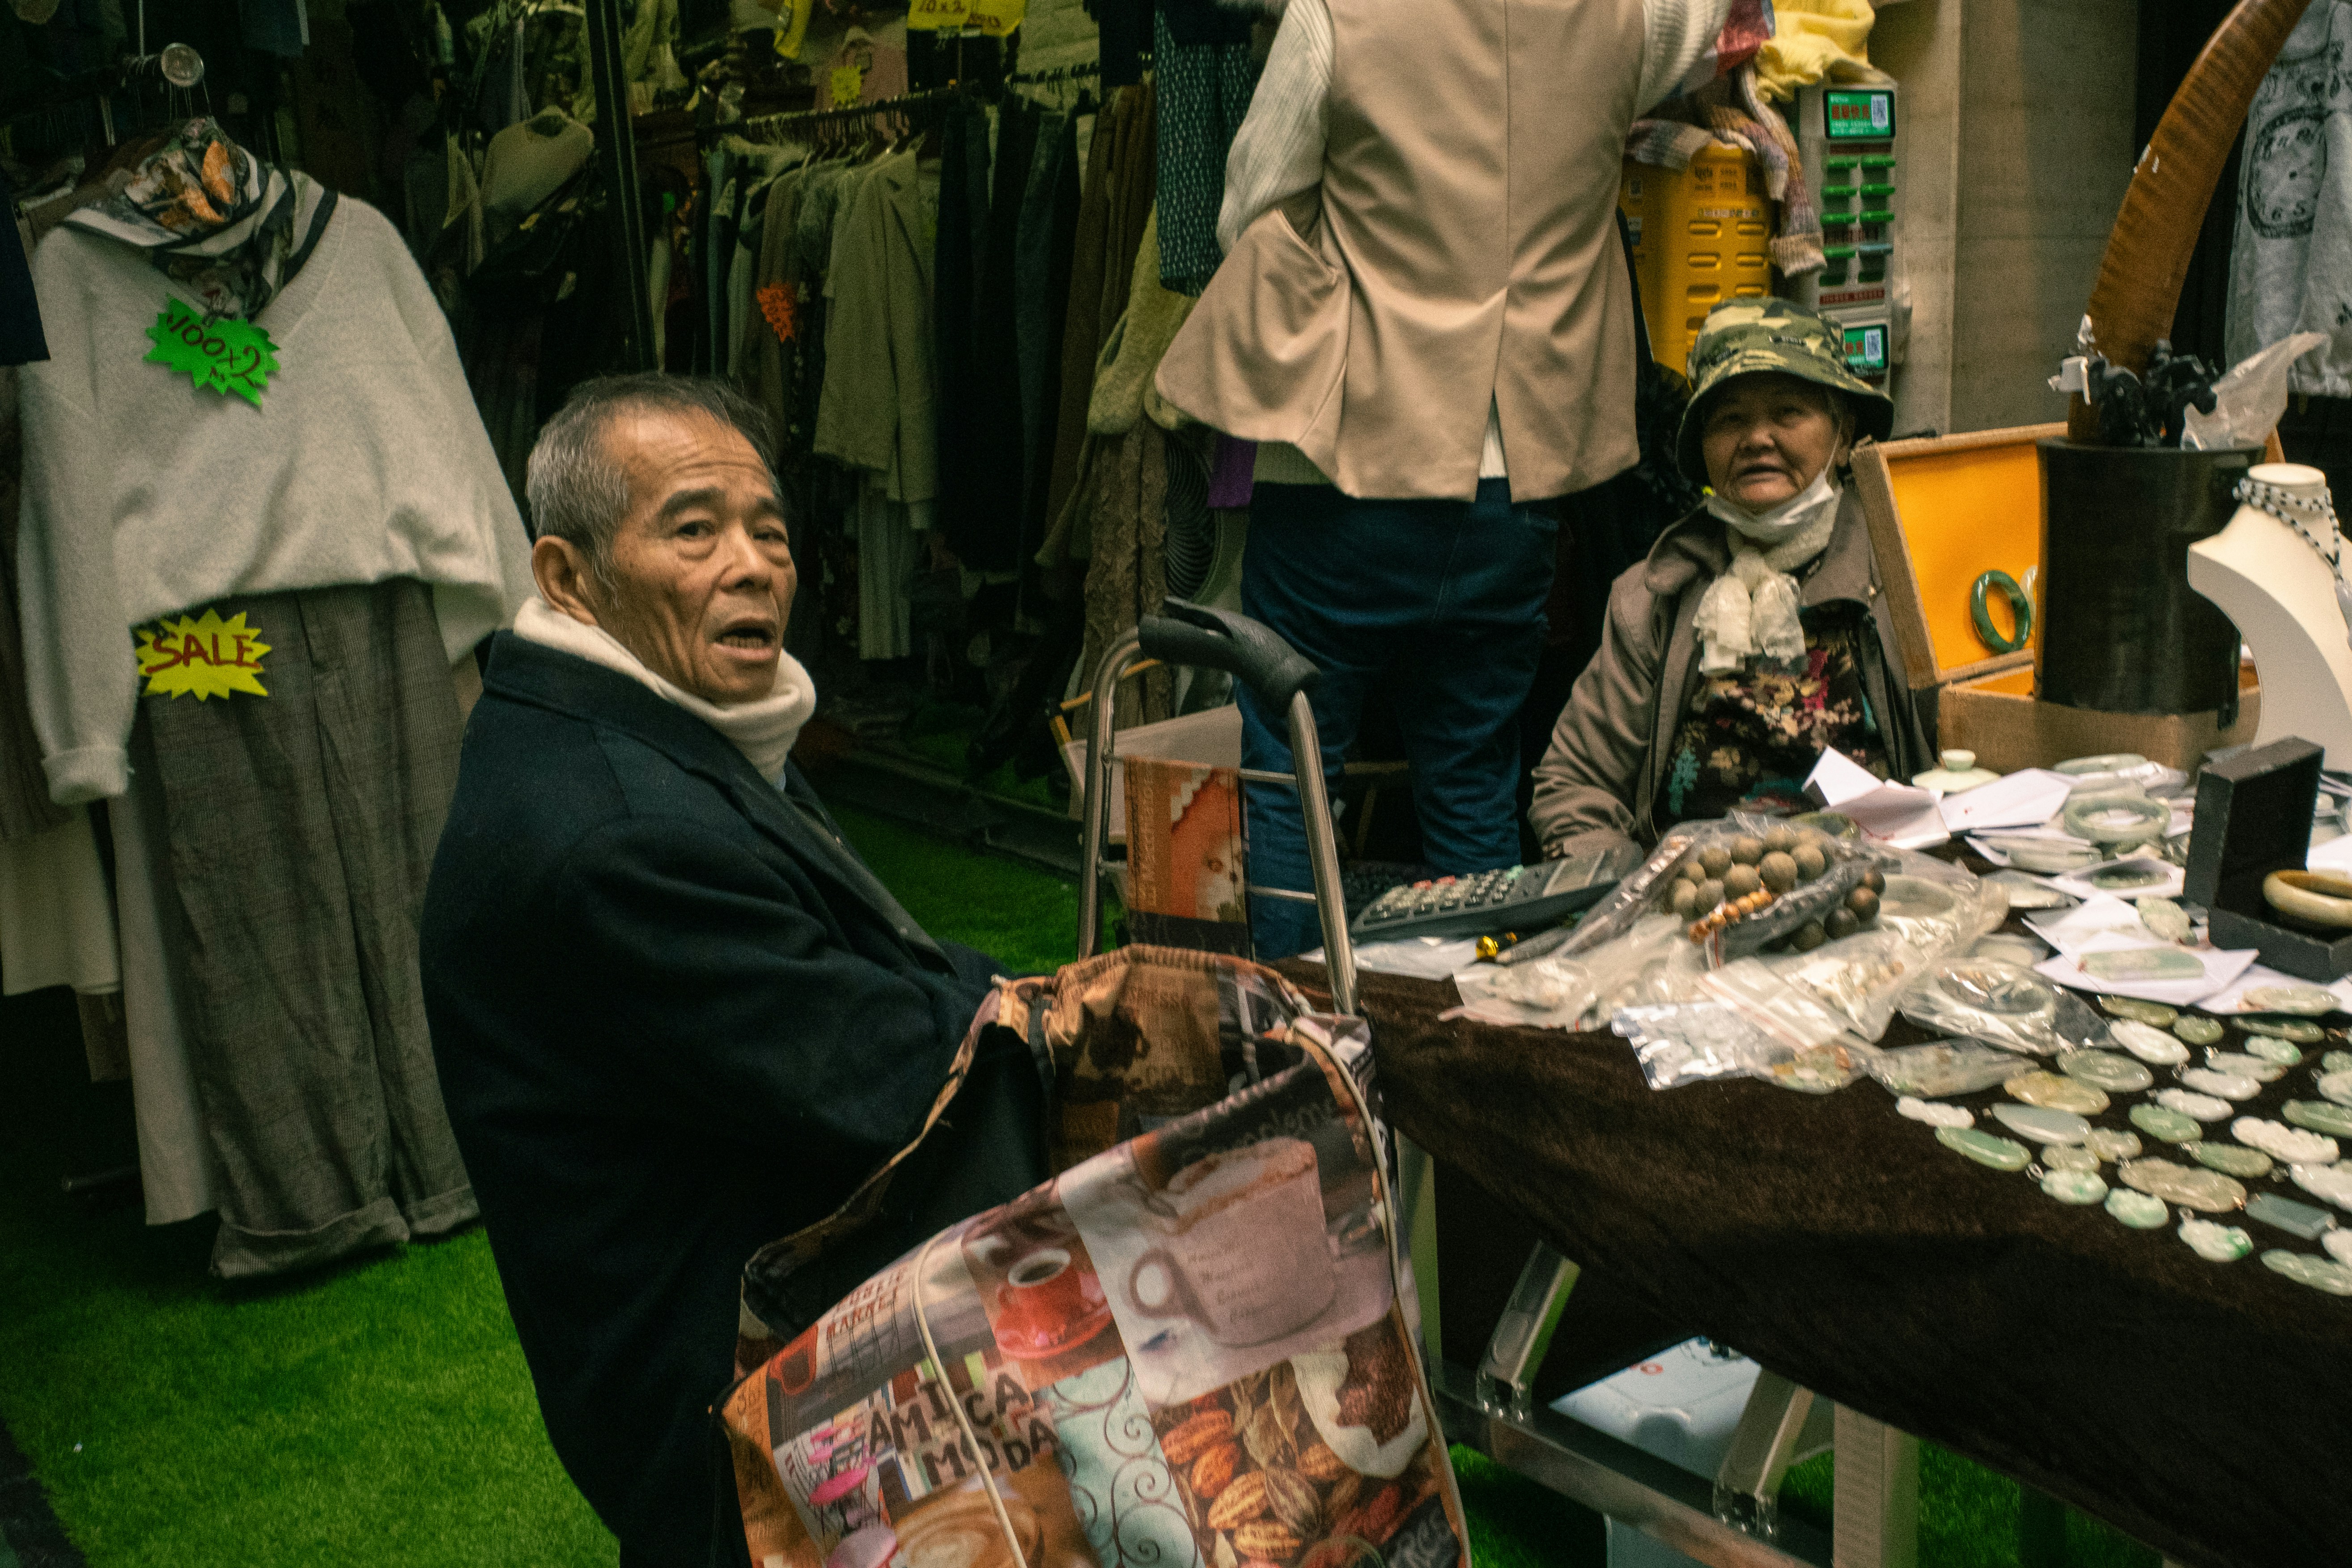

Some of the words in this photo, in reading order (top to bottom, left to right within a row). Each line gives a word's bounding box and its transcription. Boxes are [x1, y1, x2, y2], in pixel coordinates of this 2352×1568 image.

[145, 632, 262, 673] SALE
[870, 1371, 1030, 1456] AMICA
[922, 1418, 1060, 1486] MODA
